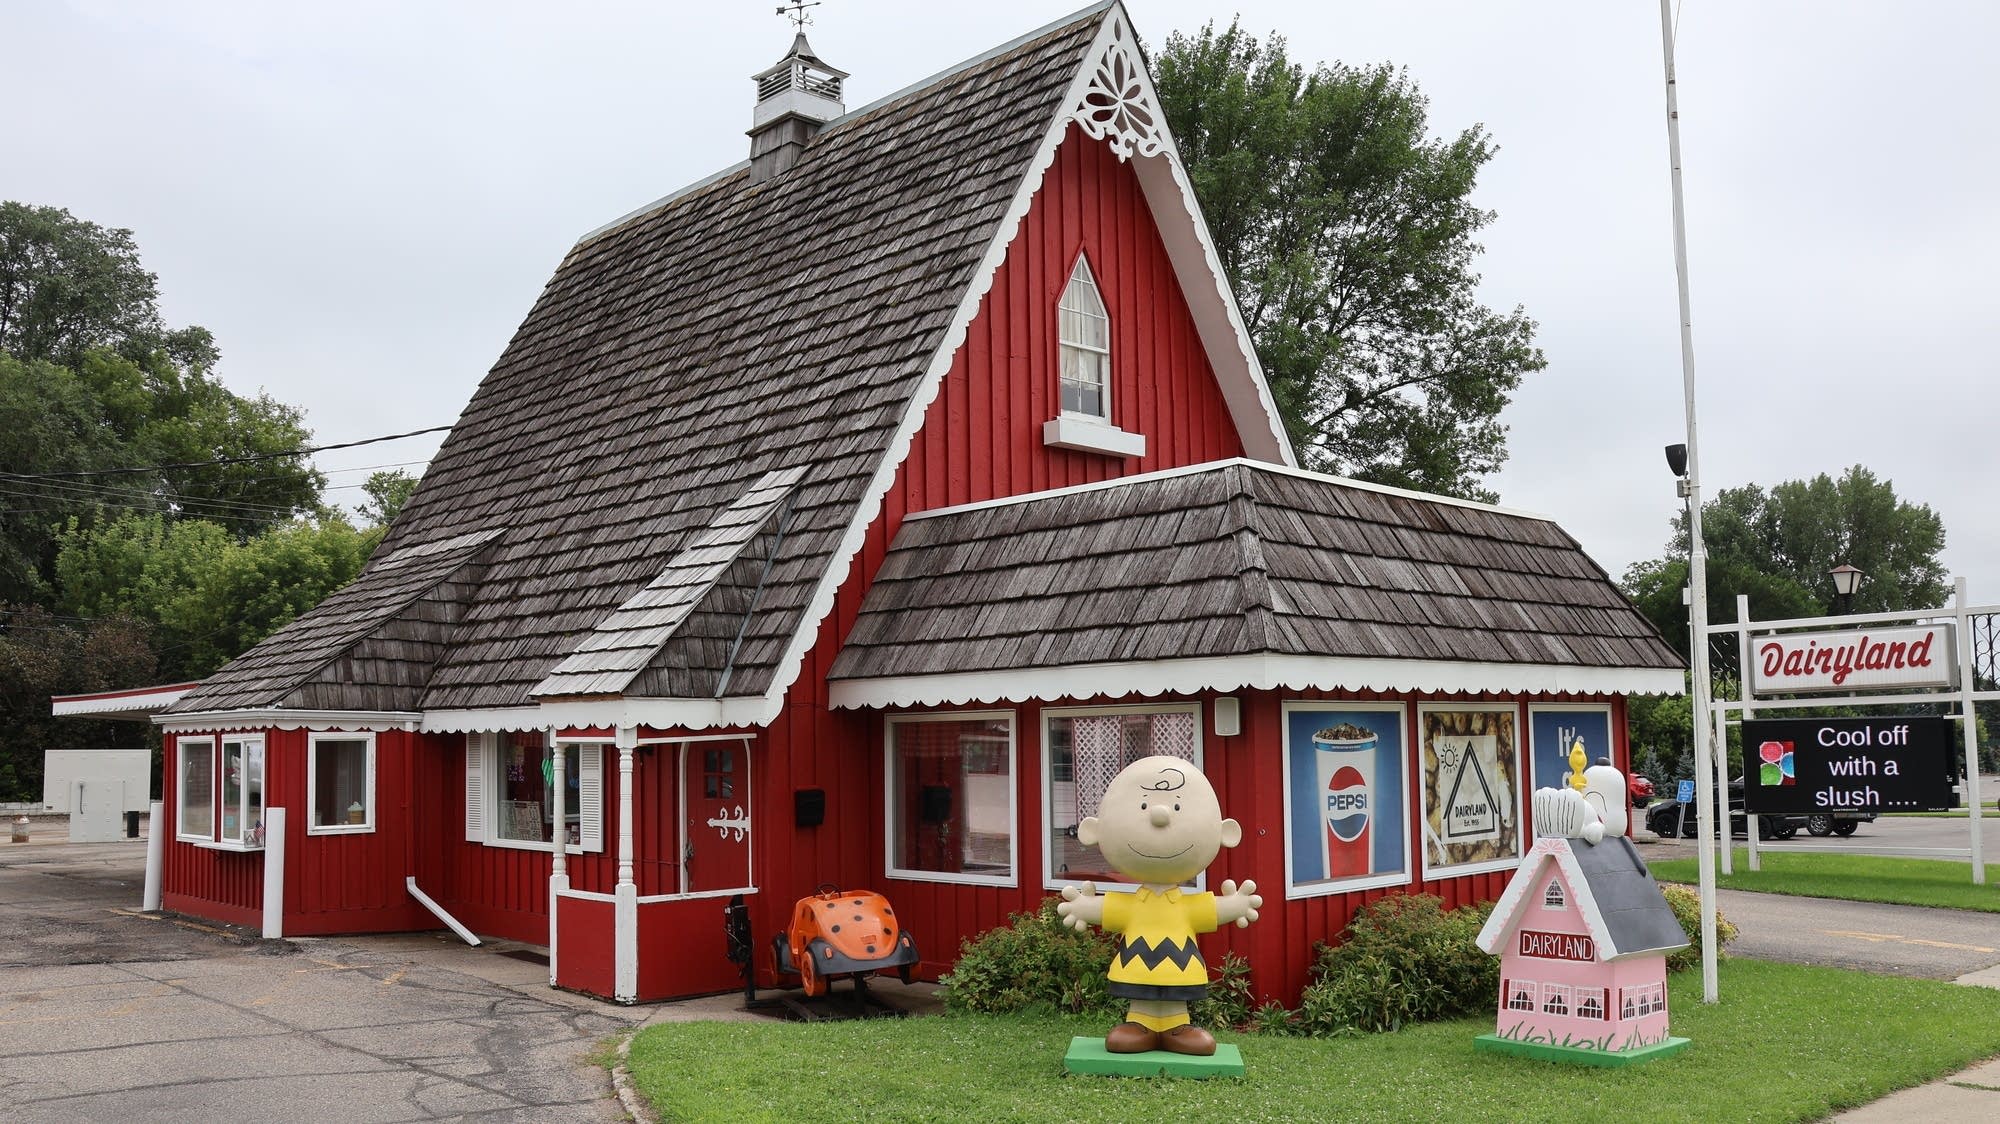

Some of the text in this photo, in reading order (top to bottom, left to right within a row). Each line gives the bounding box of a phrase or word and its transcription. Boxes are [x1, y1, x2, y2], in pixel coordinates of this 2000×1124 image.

[1760, 631, 1934, 685] Dairyland
[1817, 725, 1909, 747] Cool off
[1828, 755, 1900, 776] with a
[1327, 793, 1368, 811] PEPSI
[1815, 785, 1880, 806] slush
[1455, 803, 1487, 818] DAIRYLAND
[1522, 933, 1594, 960] DAIRYLAND
